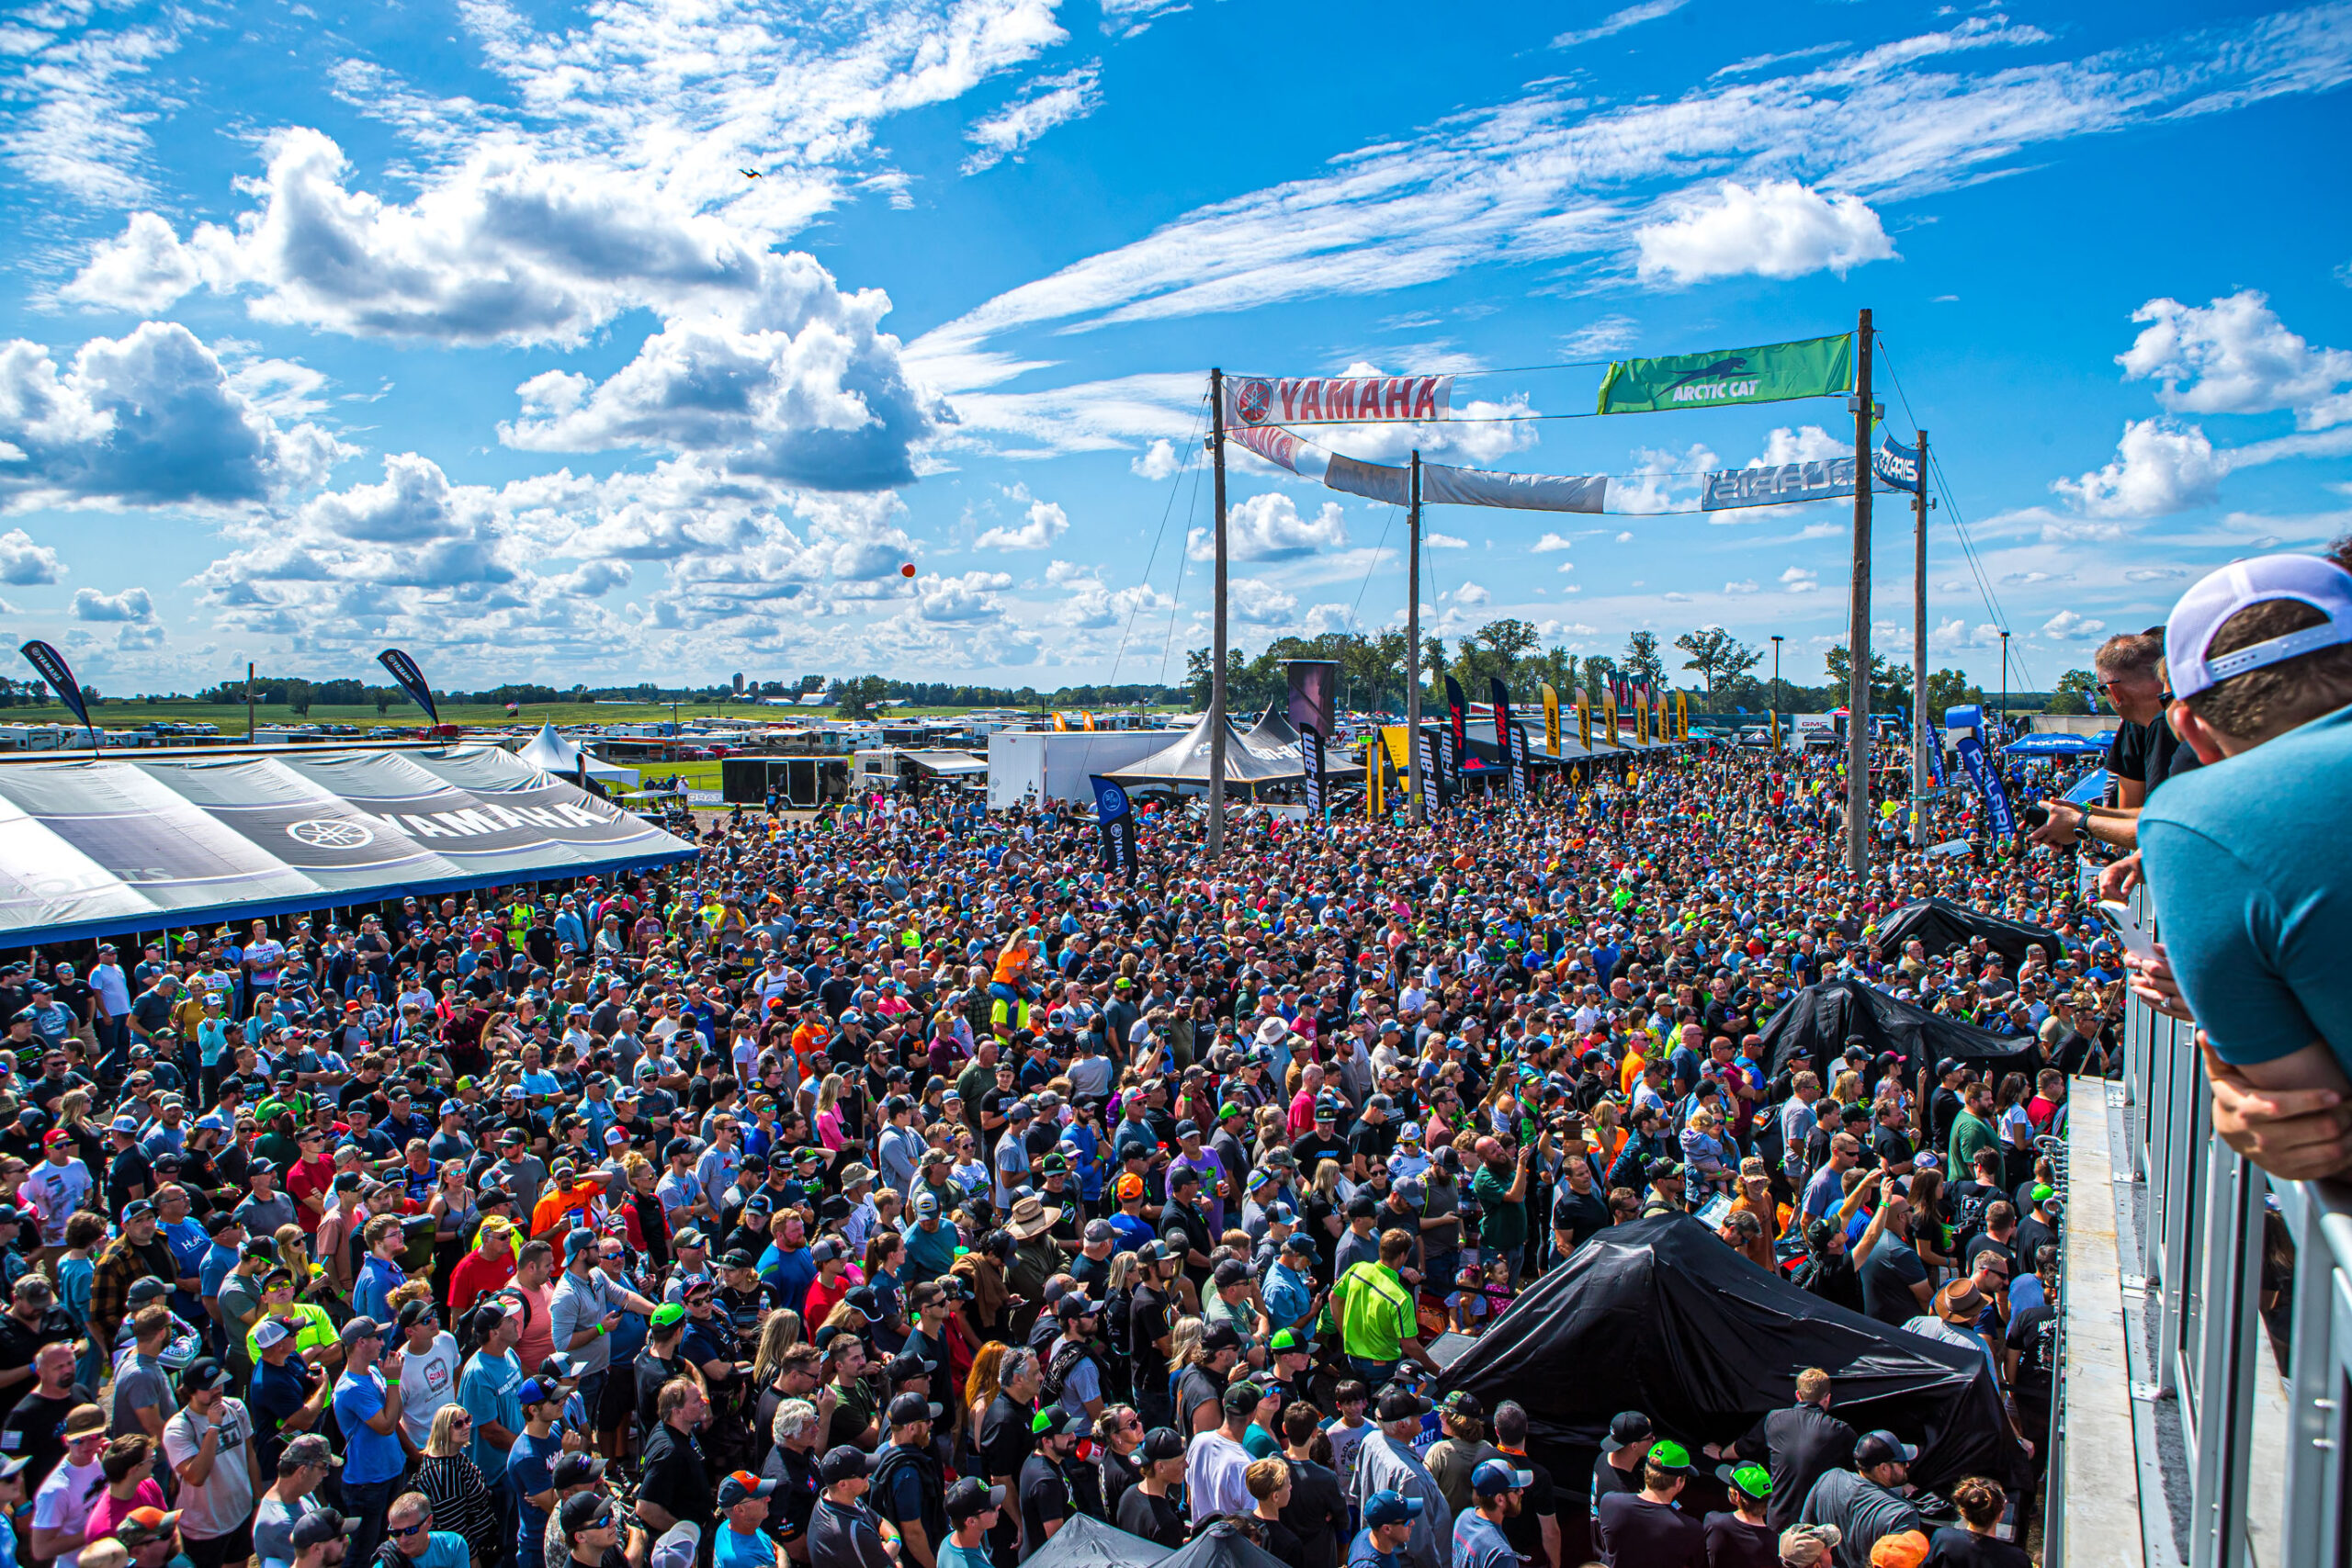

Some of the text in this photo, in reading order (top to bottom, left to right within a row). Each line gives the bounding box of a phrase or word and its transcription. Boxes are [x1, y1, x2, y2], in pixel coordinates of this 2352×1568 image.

[1280, 378, 1437, 421] YAMAHA
[1672, 380, 1758, 401] ARCTIC CAT
[38, 654, 62, 682] YAMAHA
[392, 661, 413, 683] YAMAHA
[359, 802, 611, 837] YAMAHA
[219, 1428, 243, 1449] ETI
